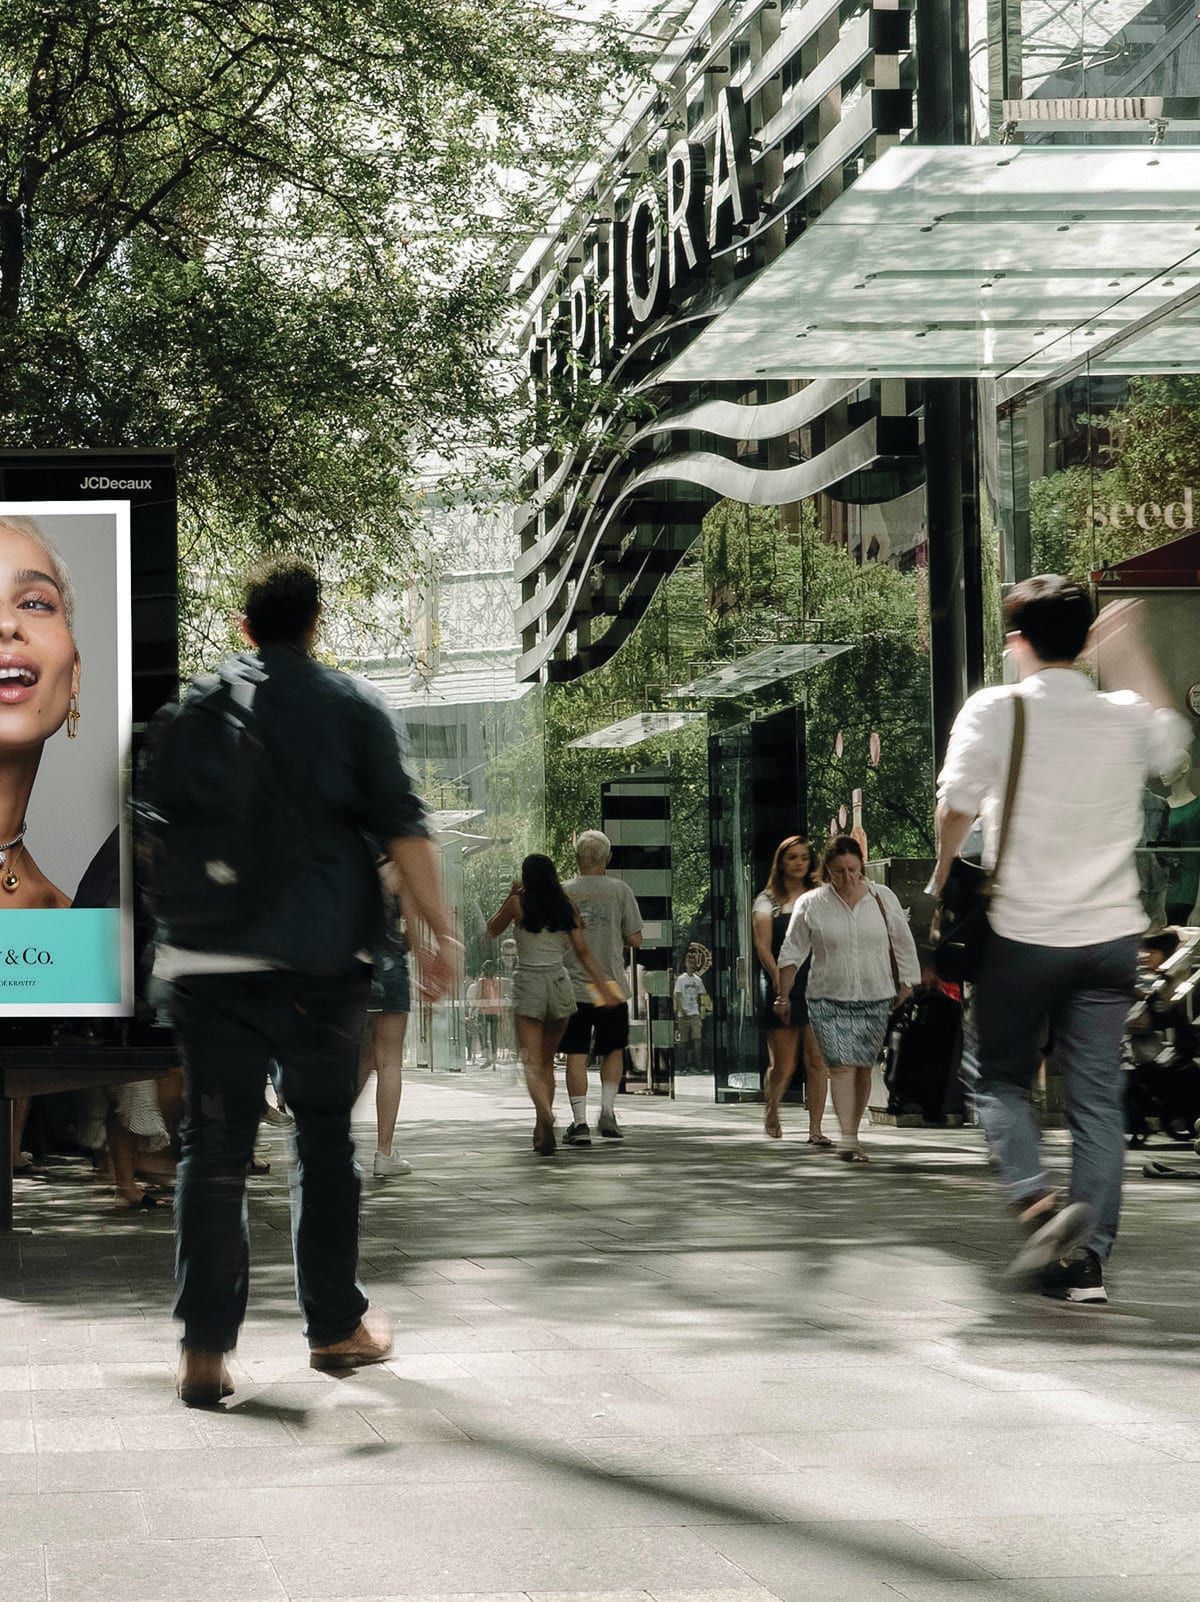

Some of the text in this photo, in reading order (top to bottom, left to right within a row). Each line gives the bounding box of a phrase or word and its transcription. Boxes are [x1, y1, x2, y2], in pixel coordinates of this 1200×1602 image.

[528, 86, 756, 412] PHORA
[80, 476, 152, 490] JCDecaux
[1085, 487, 1194, 530] seed
